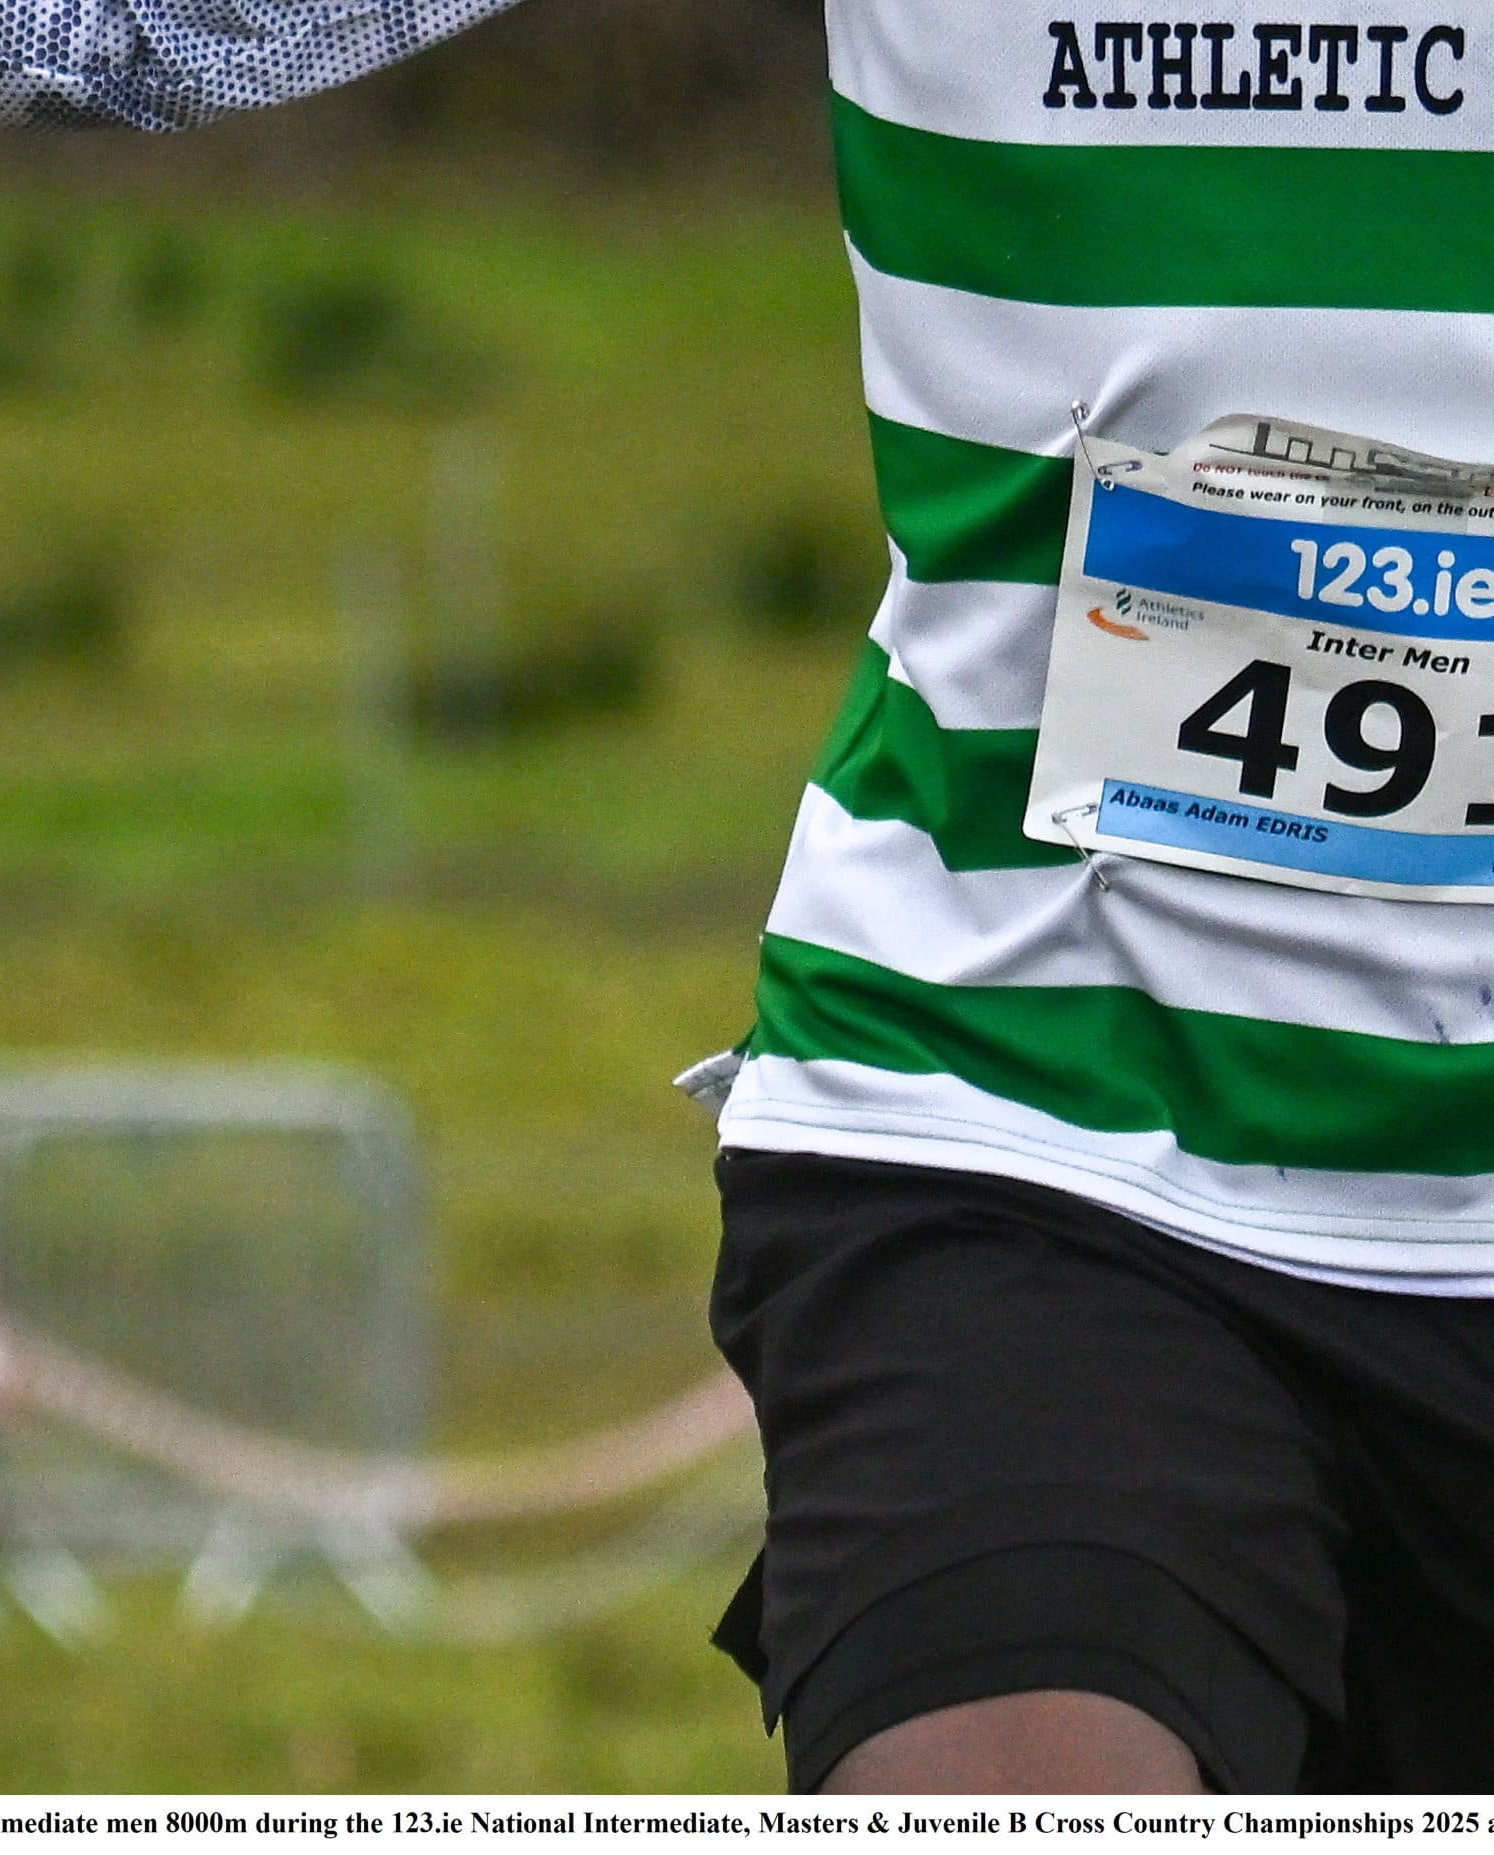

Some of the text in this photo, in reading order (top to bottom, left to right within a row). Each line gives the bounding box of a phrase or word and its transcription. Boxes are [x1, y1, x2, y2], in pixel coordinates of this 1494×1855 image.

[1043, 20, 1466, 115] ATHLETIC
[1192, 482, 1244, 499] Please
[1250, 489, 1291, 503] wear
[1295, 493, 1316, 505] on
[1320, 494, 1358, 512] your
[1362, 496, 1406, 514] front,
[1412, 502, 1432, 514] on
[1437, 502, 1464, 516] the
[1137, 610, 1189, 631] Ireland
[1306, 630, 1471, 675] Inter Men
[1109, 788, 1329, 844] Abaas Adam EDRIS
